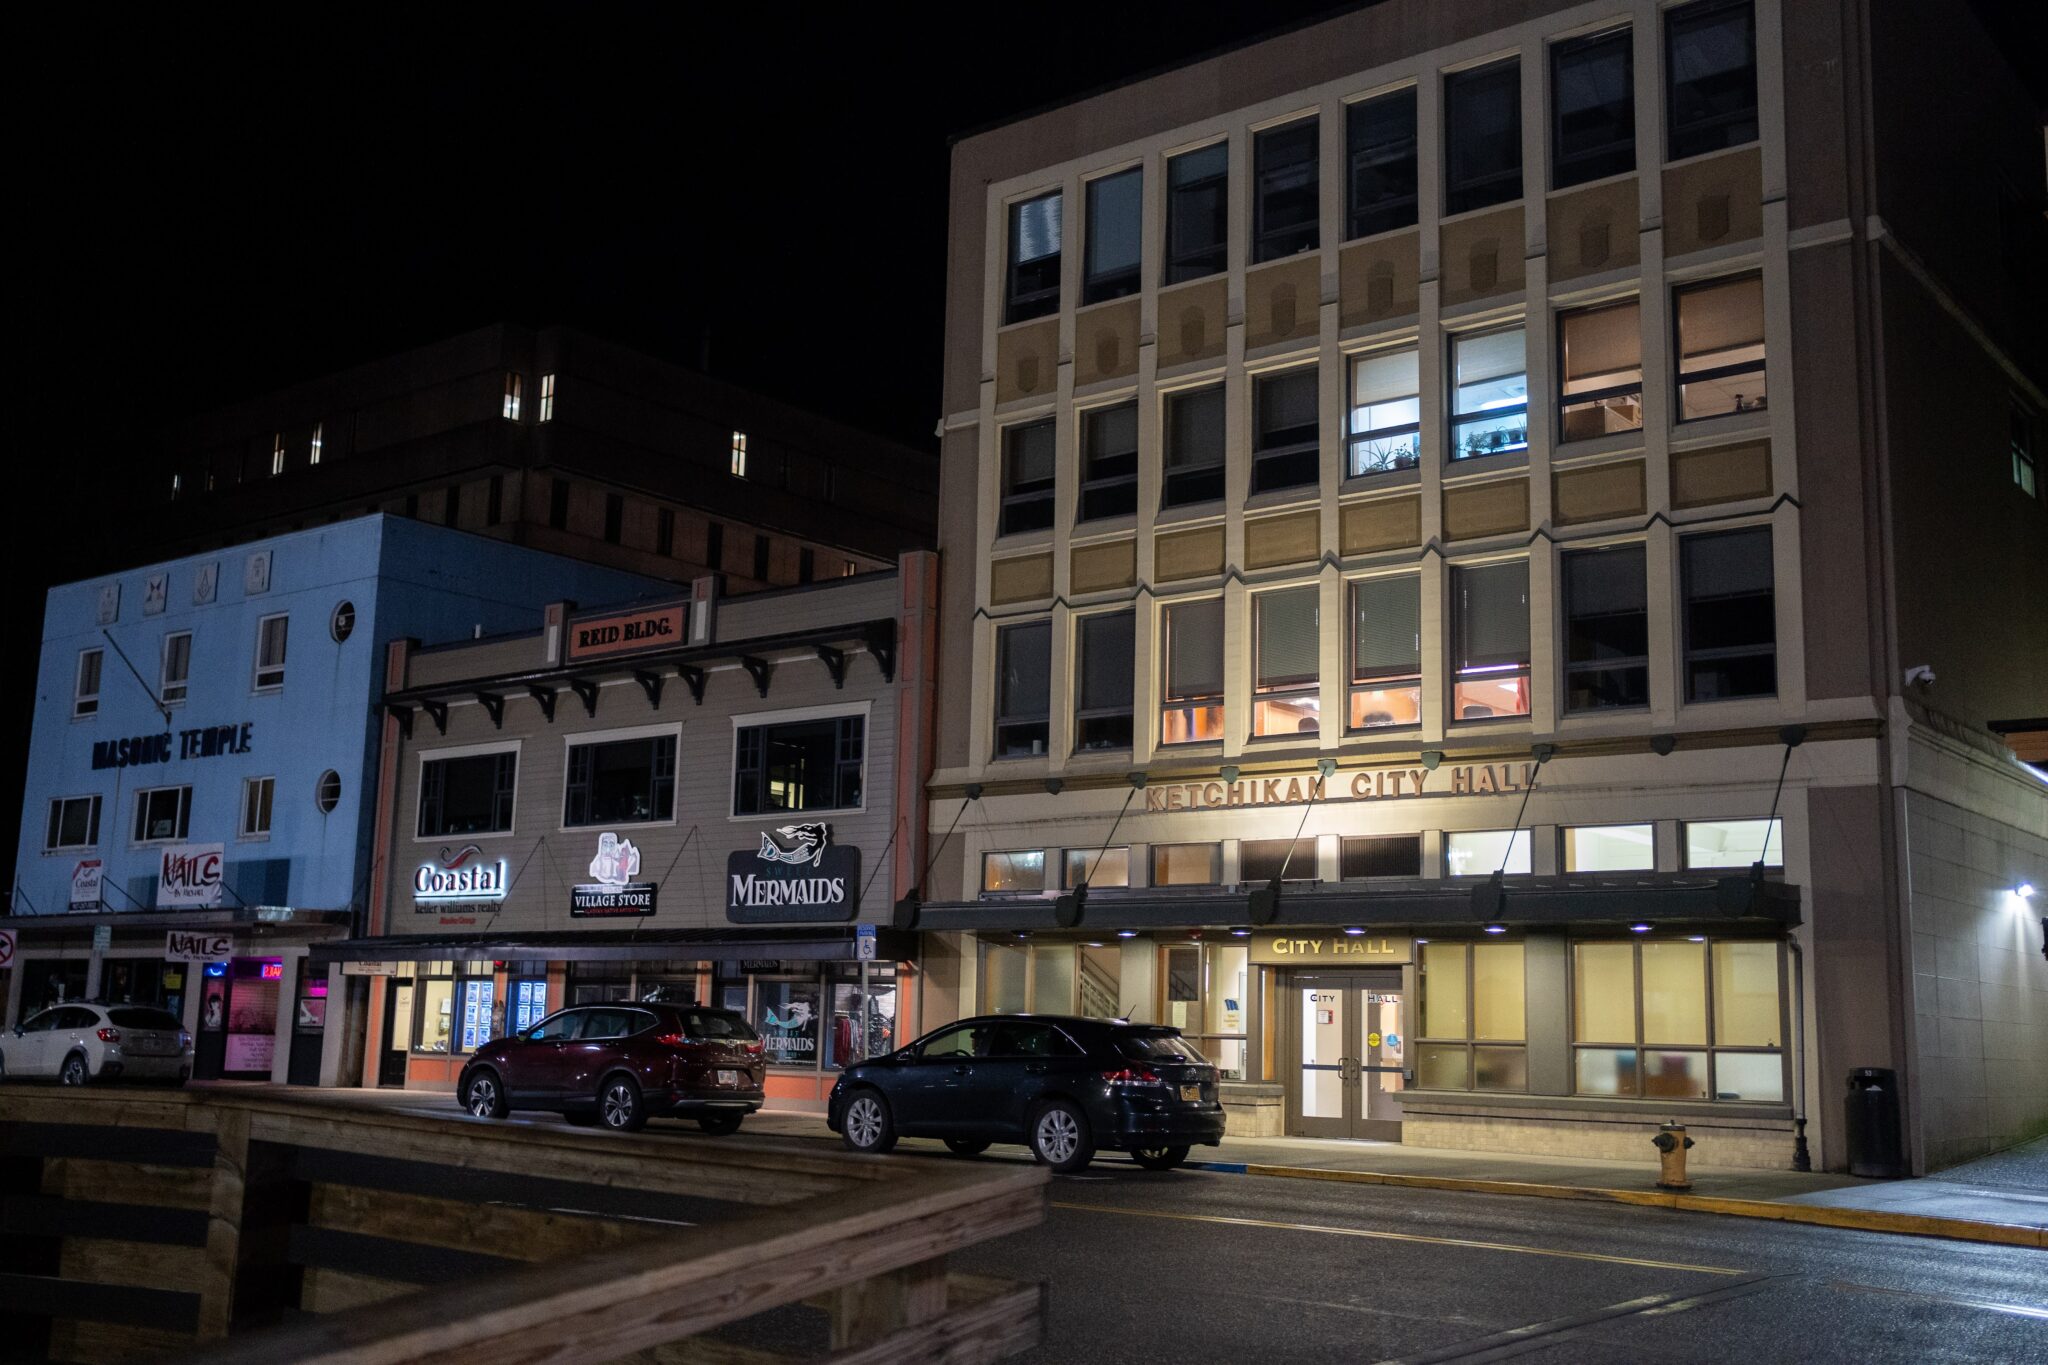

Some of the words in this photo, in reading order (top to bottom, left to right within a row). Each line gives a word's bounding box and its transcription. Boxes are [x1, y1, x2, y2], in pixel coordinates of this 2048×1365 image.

[578, 626, 619, 648] REID
[623, 617, 672, 641] BLDG.
[92, 732, 172, 770] MASONIC
[179, 722, 254, 760] TEMPLE
[1145, 776, 1326, 812] KETCHIKAN
[1350, 768, 1429, 800] CITY
[1450, 763, 1538, 795] HALL
[162, 851, 222, 888] NAILS
[415, 862, 502, 892] Coastal
[575, 895, 616, 907] VILLAGE
[618, 893, 651, 906] STORE
[730, 873, 845, 907] MERMAIDS
[415, 901, 437, 914] keller
[440, 900, 476, 913] williams
[477, 900, 502, 913] realty
[169, 932, 231, 956] NAILS
[1272, 938, 1323, 954] CITY
[1333, 938, 1394, 954] HALL
[1310, 994, 1335, 1002] CITY
[1368, 993, 1398, 1003] HALL
